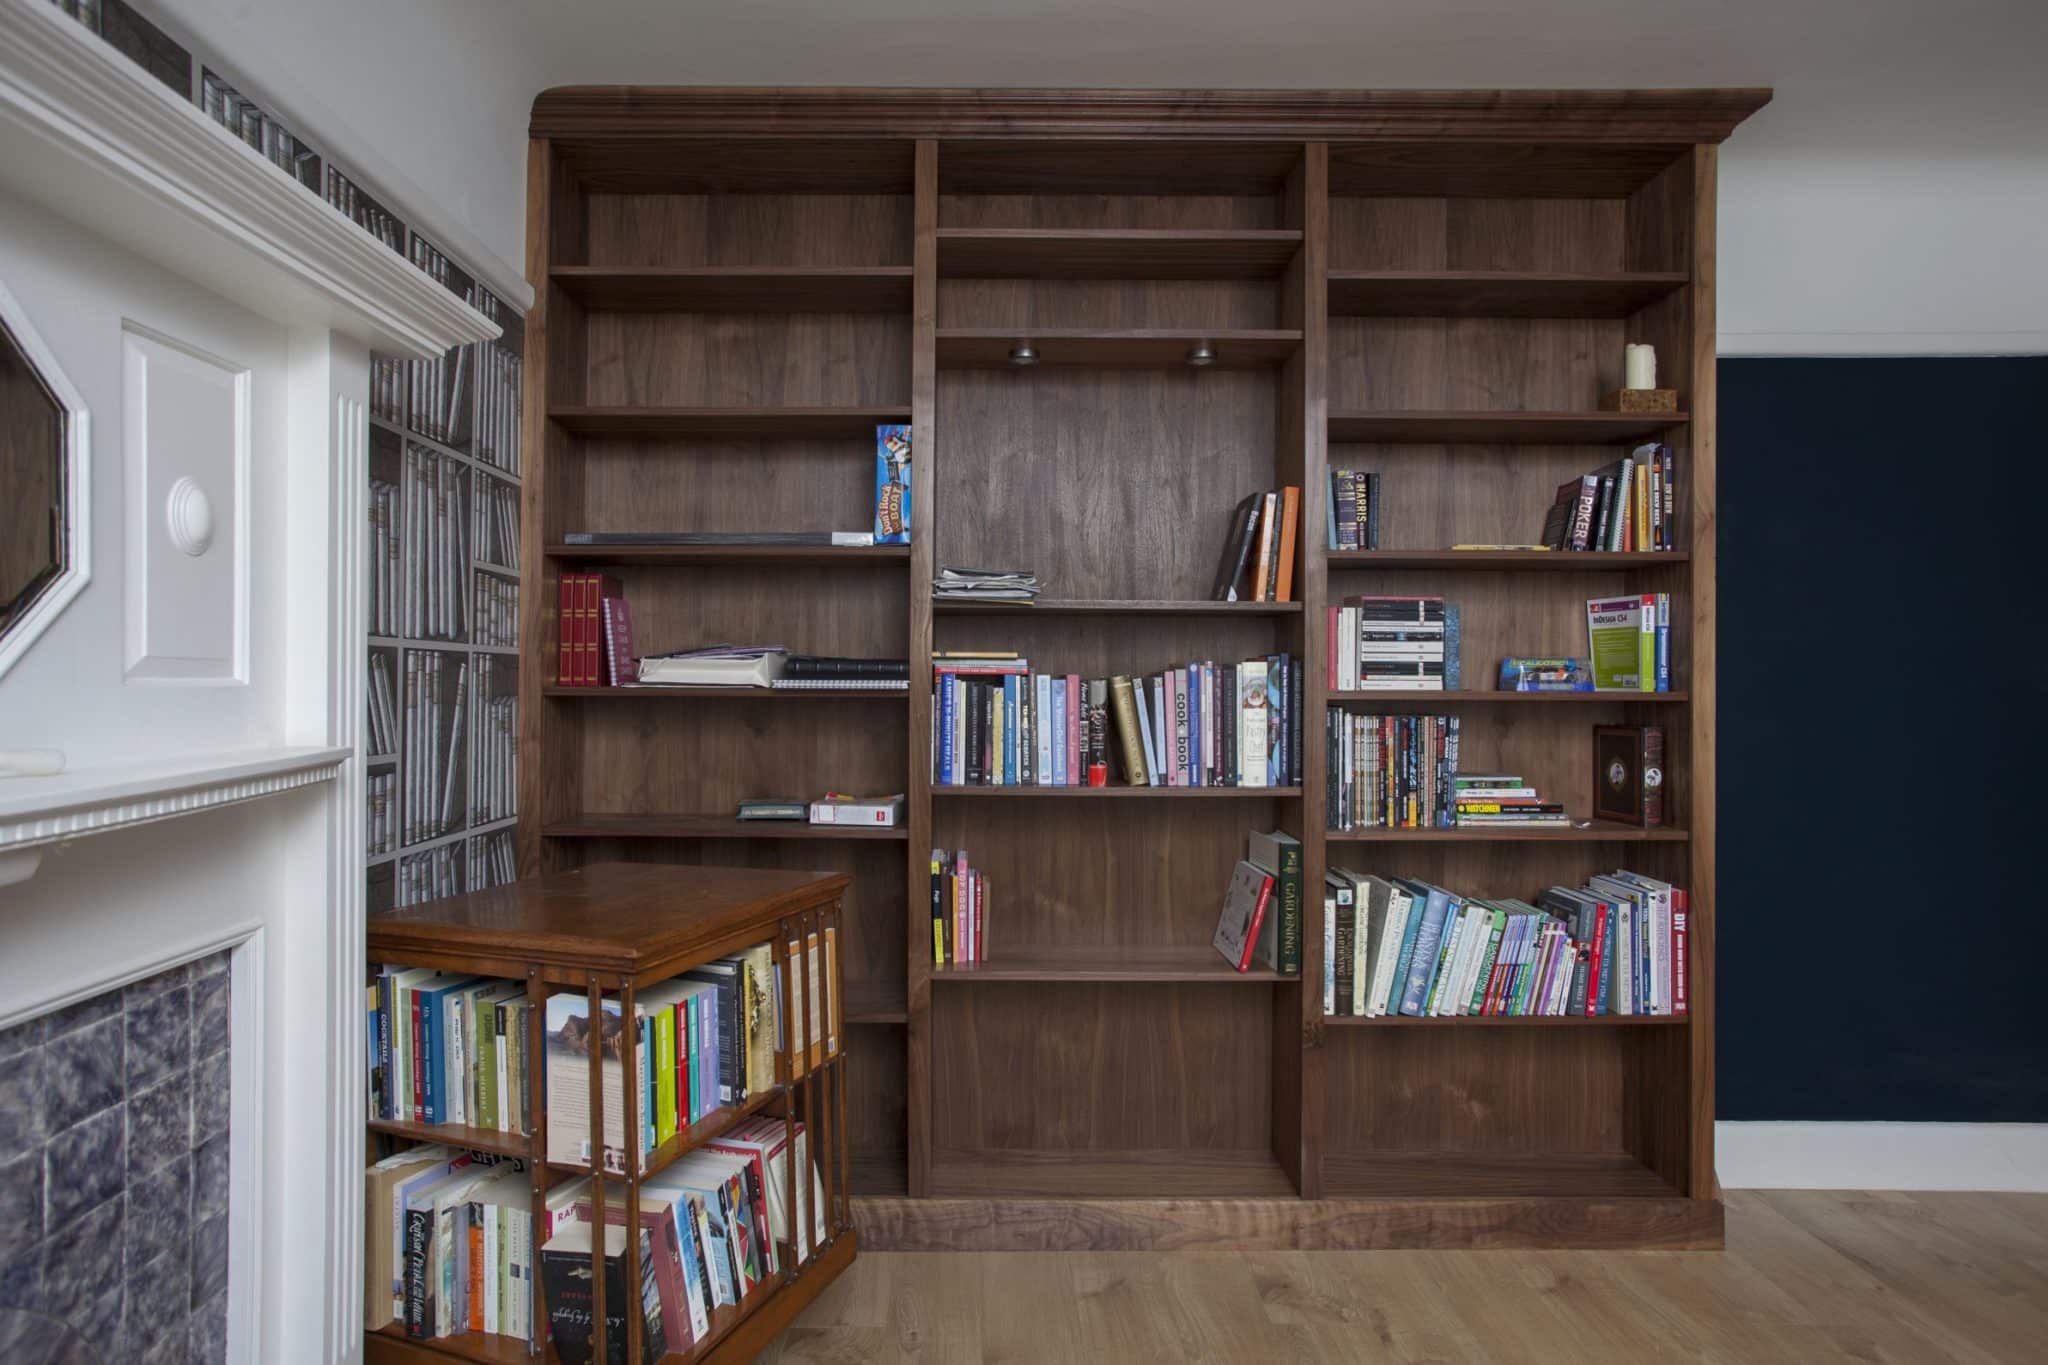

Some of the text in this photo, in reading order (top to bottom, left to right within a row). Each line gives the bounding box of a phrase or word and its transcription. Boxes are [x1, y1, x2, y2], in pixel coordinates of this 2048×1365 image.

[1356, 486, 1367, 522] HARRIS
[1574, 495, 1593, 539] POKER
[1177, 693, 1188, 771] cook book
[1285, 882, 1296, 955] GARDENING
[1674, 913, 1685, 932] DIY
